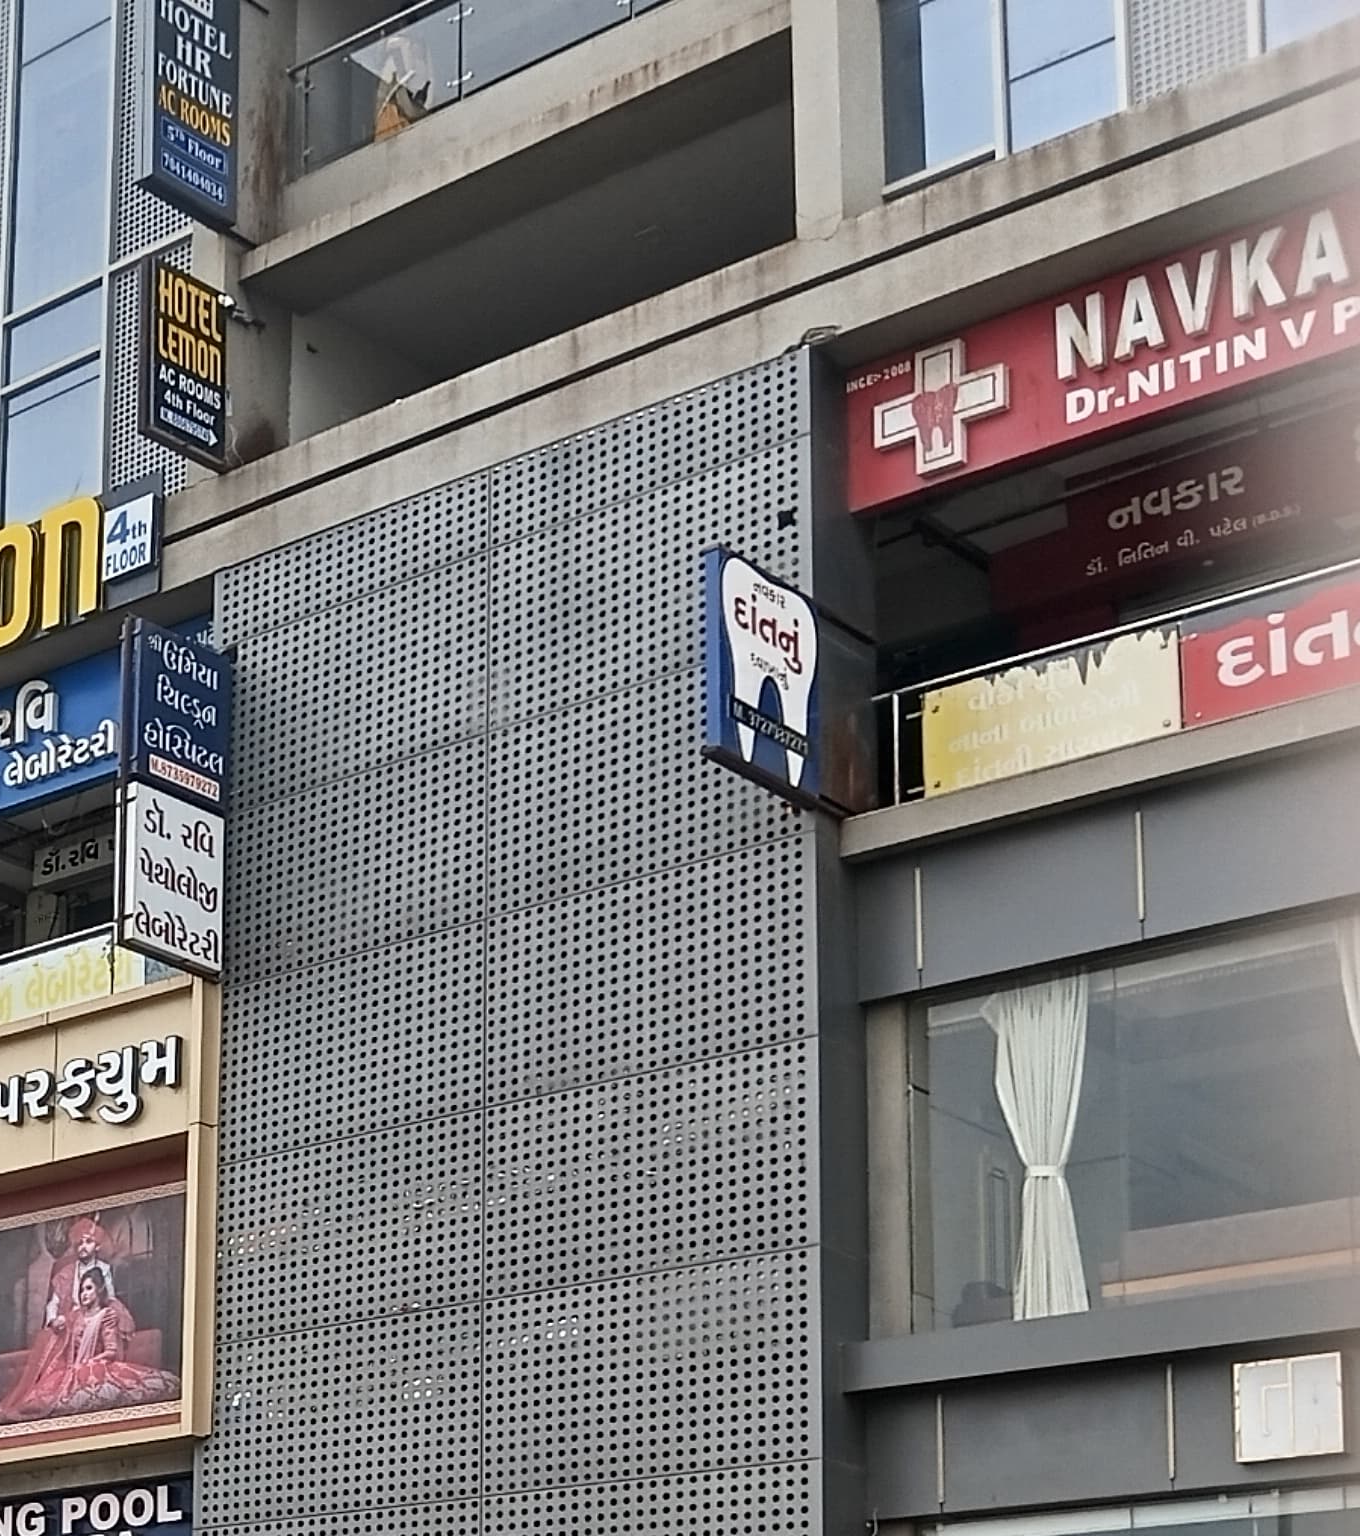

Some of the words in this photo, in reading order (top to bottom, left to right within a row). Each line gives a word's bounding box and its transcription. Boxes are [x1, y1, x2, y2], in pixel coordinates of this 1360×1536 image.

[160, 0, 232, 59] HOTEL
[176, 34, 212, 78] HR
[157, 51, 232, 118] FORTUNE
[160, 84, 176, 115] AC
[181, 98, 230, 146] ROOMS
[188, 138, 222, 169] Floor
[158, 267, 222, 342] HOTEL
[1280, 310, 1317, 349] V
[158, 318, 222, 386] LEMON
[159, 364, 176, 388] AC
[179, 373, 222, 410] ROOMS
[164, 389, 184, 414] 4th
[186, 398, 216, 426] Floor
[1107, 465, 1246, 531] નવકાર
[106, 510, 148, 546] 4th
[1117, 541, 1170, 567] નિતિન
[1209, 518, 1248, 539] પટેલ
[105, 541, 147, 576] FLOOR
[163, 640, 219, 691] ઉમિયા
[3, 718, 119, 788] લેબોરેટરી
[144, 717, 224, 776] હોસ્પિટલ
[180, 820, 215, 859] રવિ
[139, 847, 218, 913] પેથોલોજી
[134, 901, 220, 965] લેબોરેટરી
[61, 1484, 183, 1532] POOL
